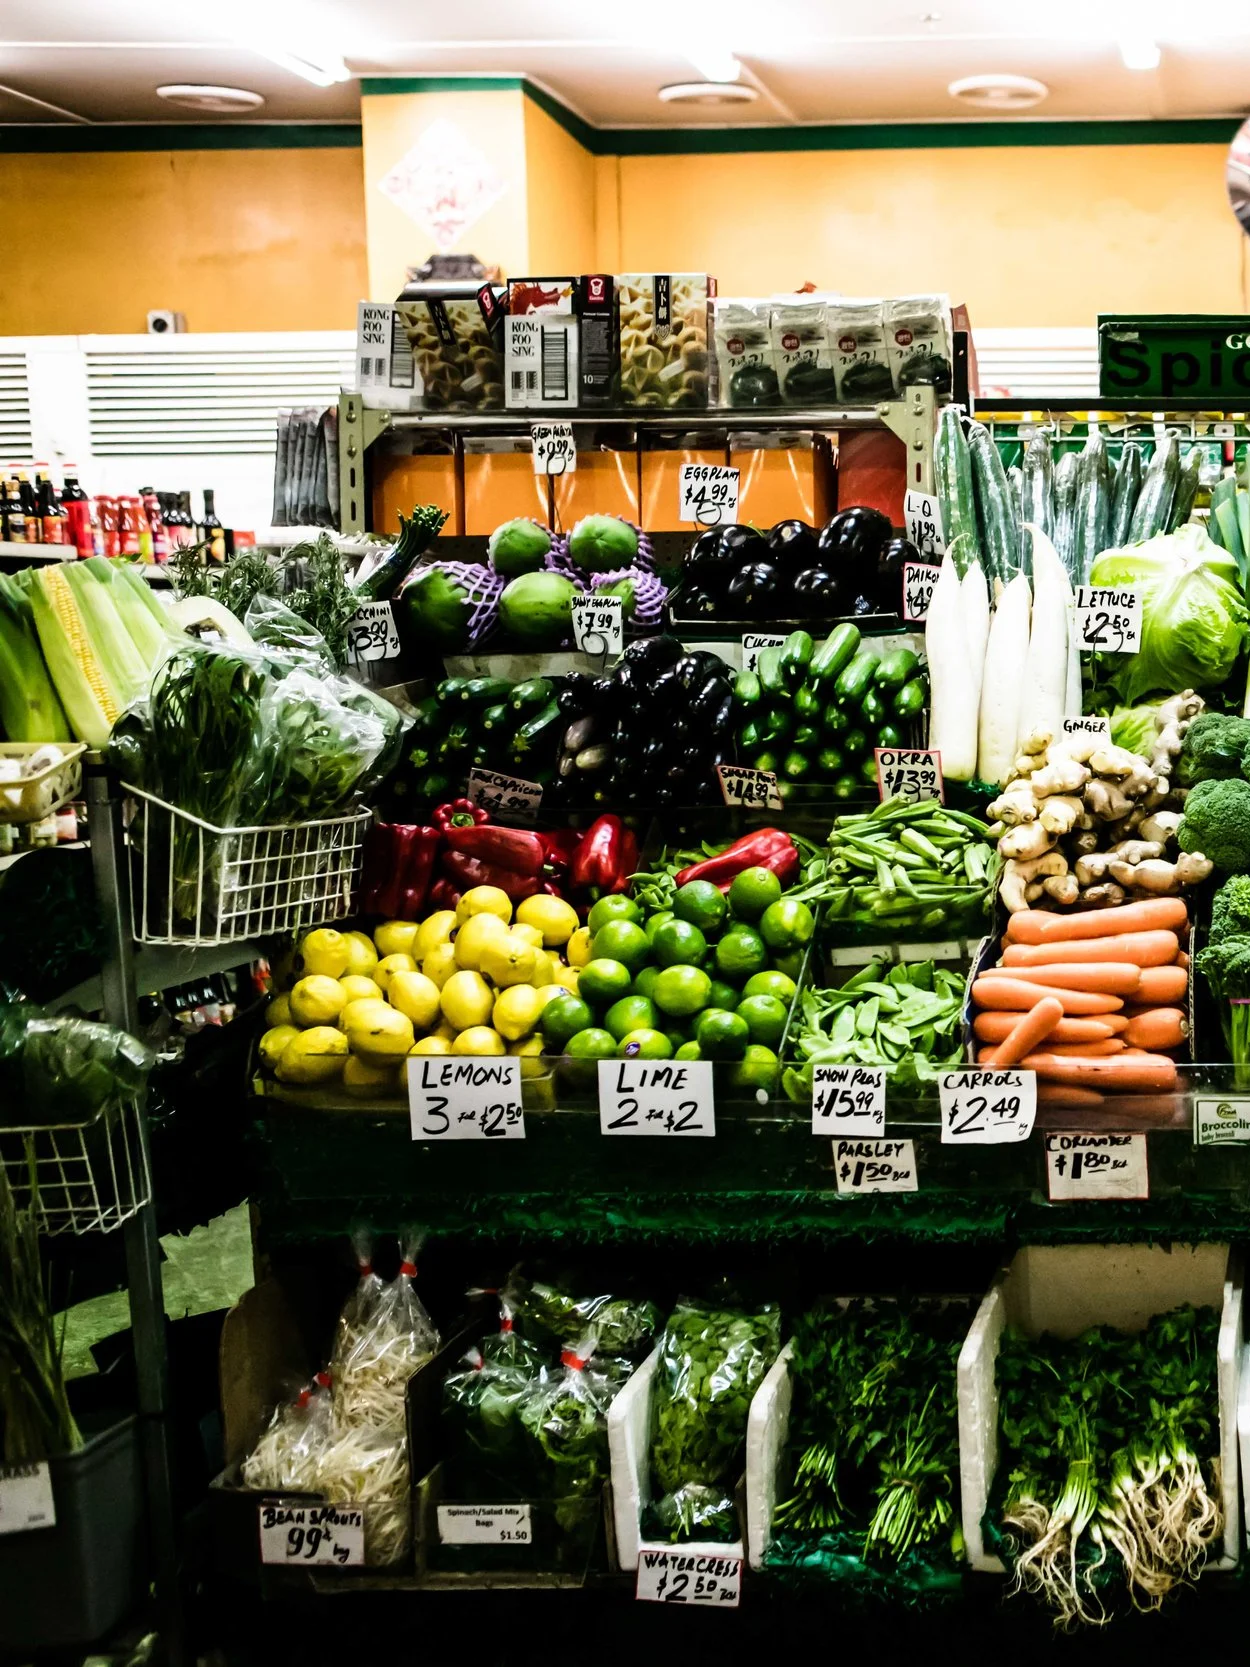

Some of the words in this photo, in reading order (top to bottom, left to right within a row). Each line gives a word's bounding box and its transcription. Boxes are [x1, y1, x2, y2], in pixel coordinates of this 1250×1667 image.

[363, 309, 390, 320] KONG
[363, 321, 382, 332] FOO
[511, 321, 539, 333] KONG
[363, 333, 385, 344] SING
[512, 336, 531, 345] FOO
[512, 346, 535, 357] SING
[583, 374, 594, 384] 10
[684, 466, 740, 481] EGGPLANT
[1077, 588, 1136, 609] LETTUCE
[357, 606, 390, 621] CCHINI
[880, 751, 934, 766] OKRA
[422, 1061, 513, 1089] LEMONS
[616, 1062, 688, 1094] LIME
[422, 1096, 450, 1135] 3
[607, 1098, 639, 1130] 2
[663, 1101, 704, 1133] $2
[837, 1140, 905, 1161] PARSLEY
[1045, 1134, 1133, 1152] CORIANDER
[263, 1507, 305, 1529] BEAN
[447, 1508, 503, 1516] Spinach/Salad
[475, 1519, 494, 1528] Bags
[500, 1530, 528, 1541] $1.50
[644, 1552, 740, 1578] WATERCRESS
